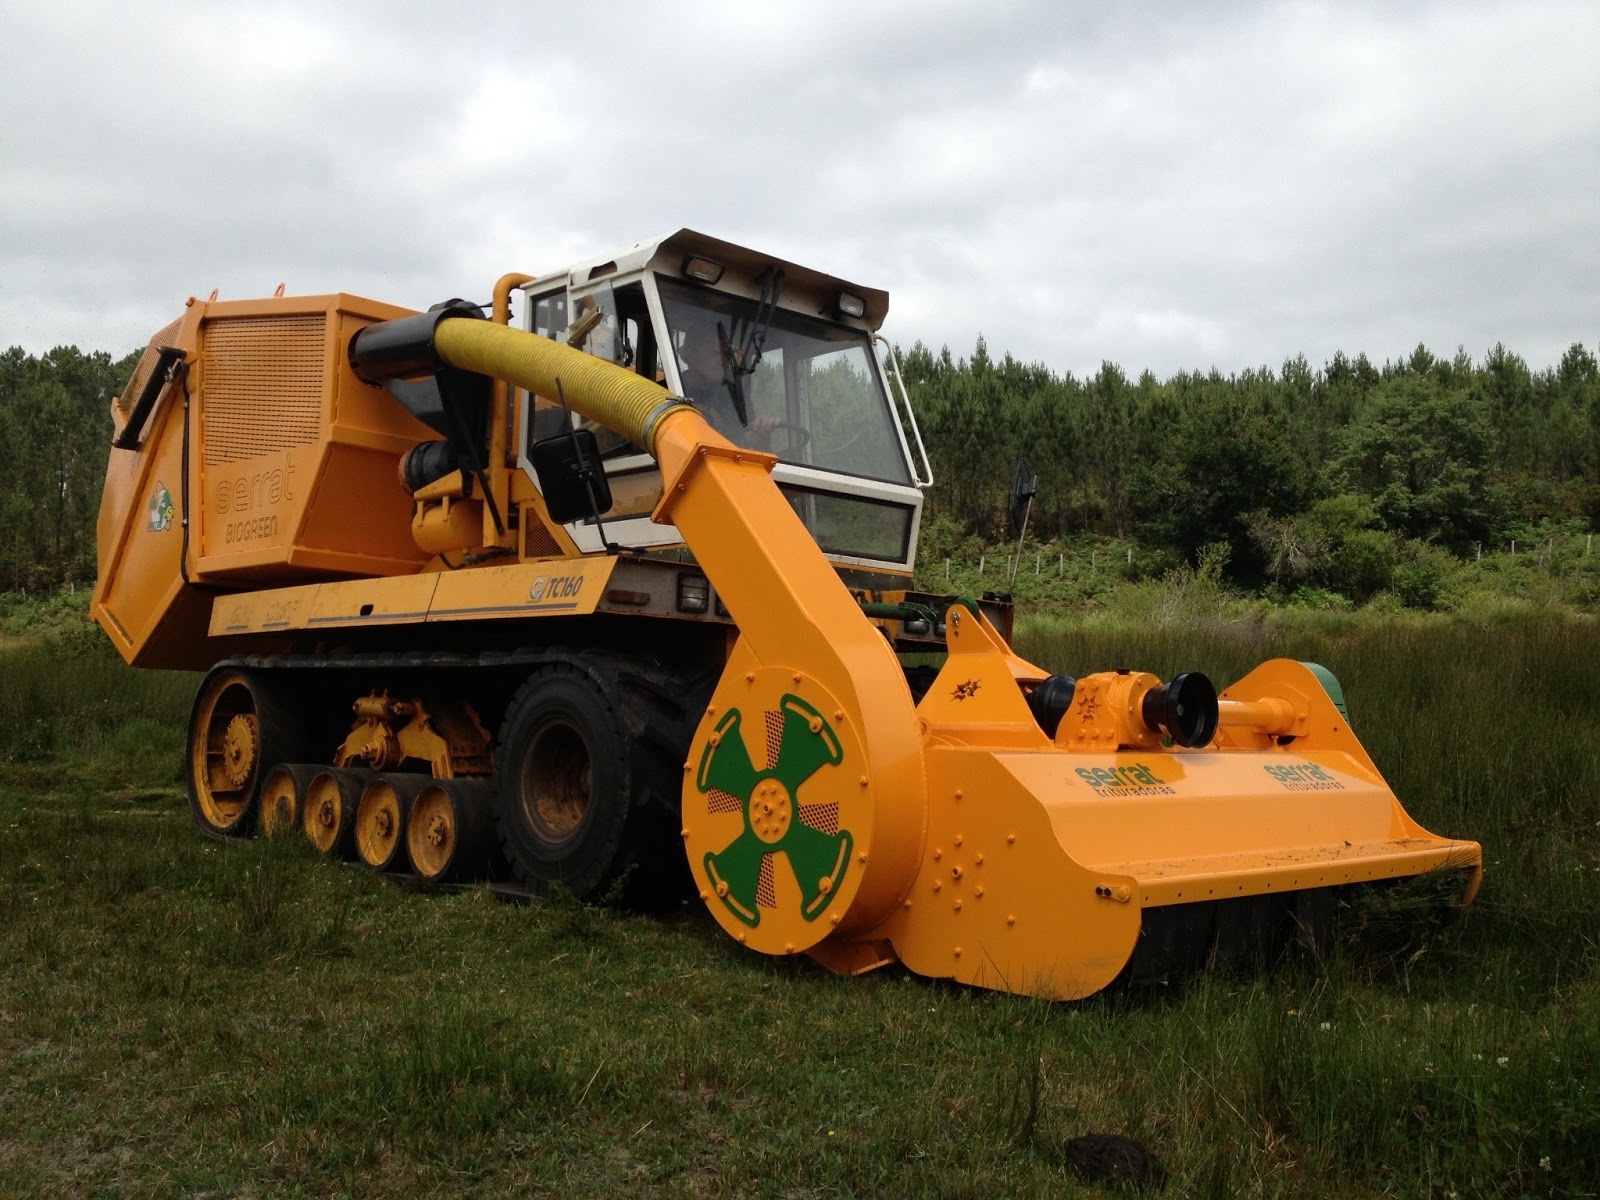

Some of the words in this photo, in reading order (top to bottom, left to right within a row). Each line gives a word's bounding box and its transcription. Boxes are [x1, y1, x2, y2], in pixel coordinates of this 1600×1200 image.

[216, 453, 295, 515] serrat
[225, 515, 278, 544] BIOGREEN
[546, 575, 584, 599] TC160
[1074, 763, 1166, 787] serrat
[1263, 761, 1335, 782] serrat
[1093, 785, 1176, 798] trituradoras
